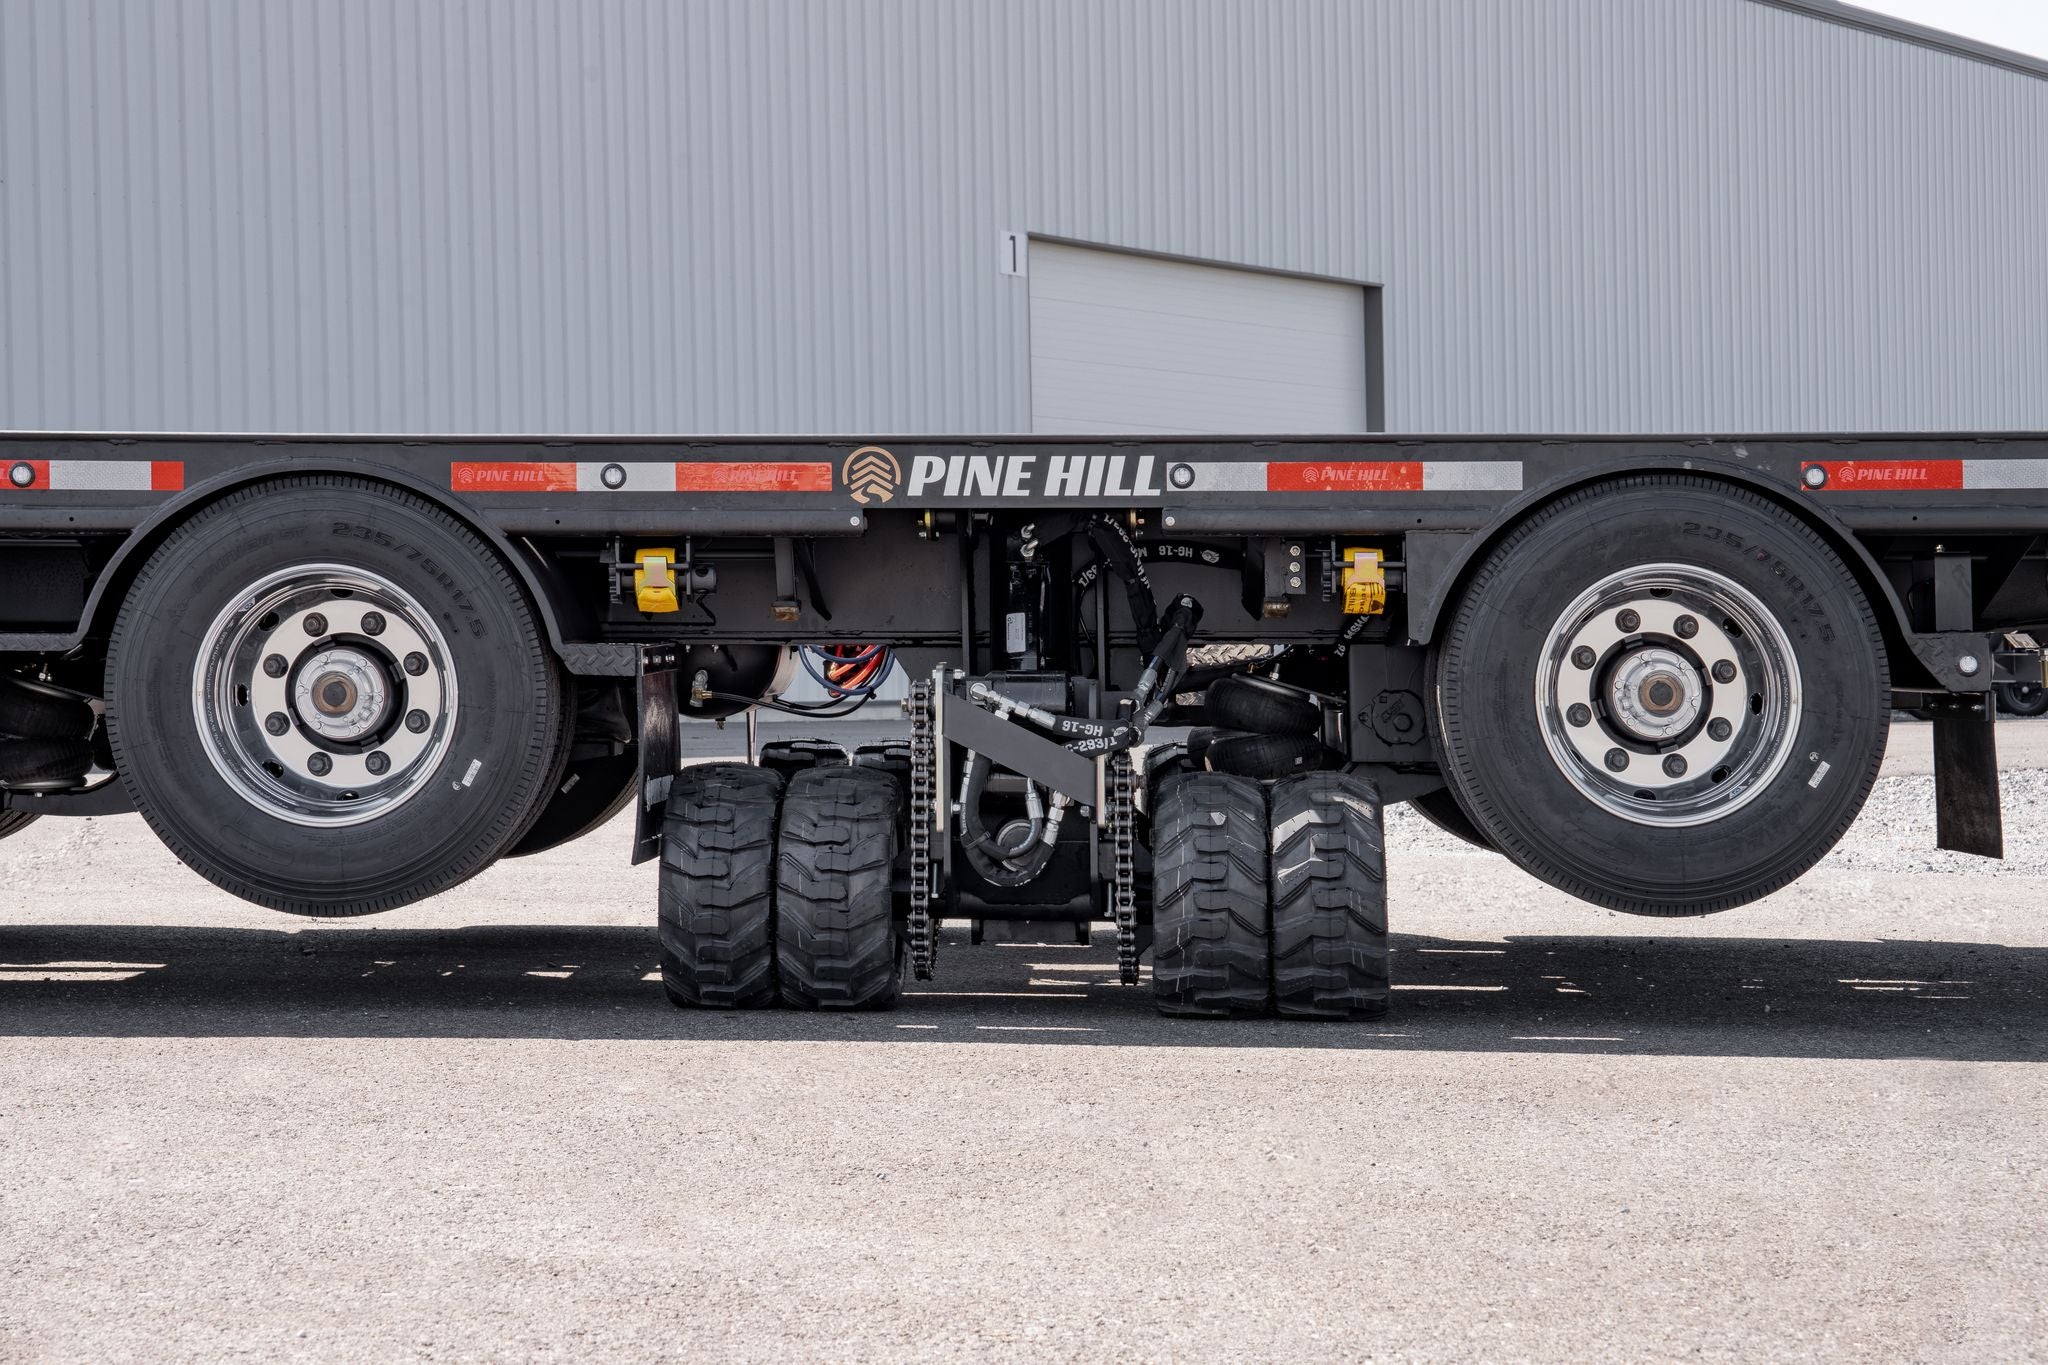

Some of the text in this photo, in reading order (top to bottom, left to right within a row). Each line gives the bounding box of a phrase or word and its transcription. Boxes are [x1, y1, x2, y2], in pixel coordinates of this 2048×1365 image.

[1009, 235, 1016, 273] 1
[476, 470, 545, 482] PINE HILL
[907, 455, 1162, 497] PINE HILL
[1320, 469, 1390, 481] PINE HILL
[1857, 468, 1928, 481] PINE HILL
[1158, 545, 1193, 557] HG-16
[332, 522, 488, 639] 235/75R17.5
[1062, 720, 1104, 737] HG-16
[1063, 736, 1118, 753] C-293/1
